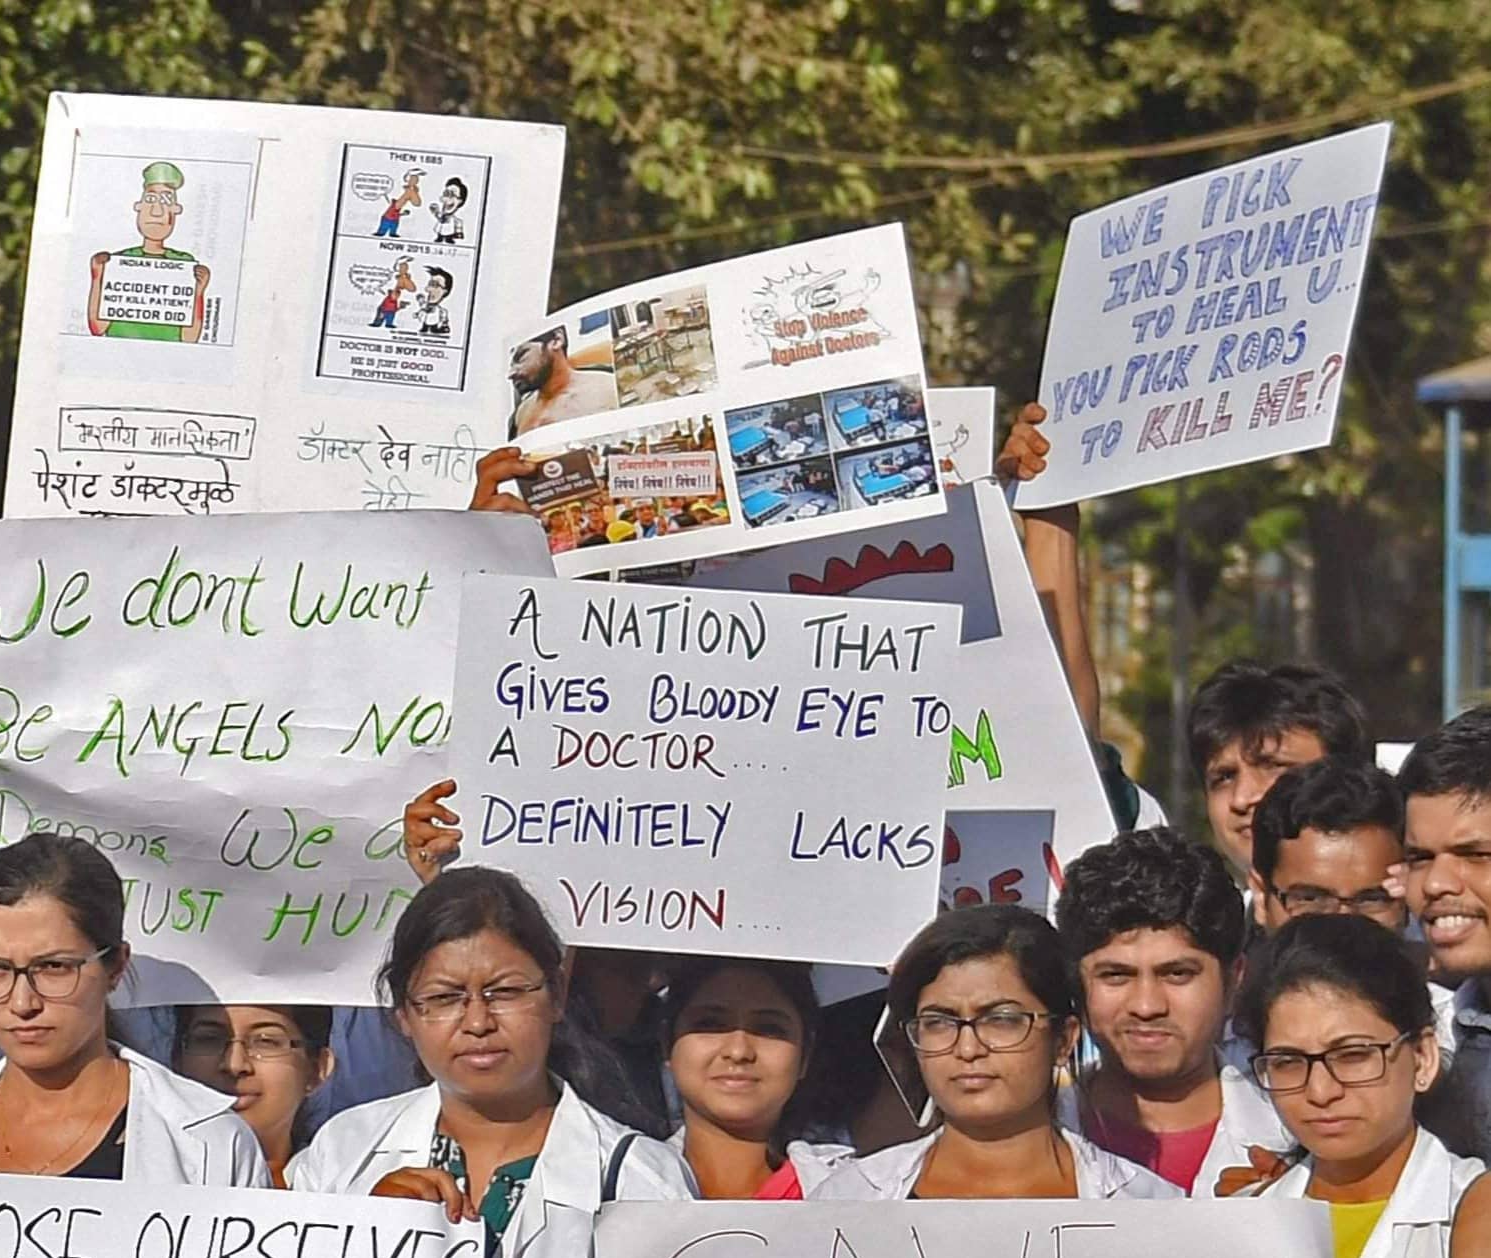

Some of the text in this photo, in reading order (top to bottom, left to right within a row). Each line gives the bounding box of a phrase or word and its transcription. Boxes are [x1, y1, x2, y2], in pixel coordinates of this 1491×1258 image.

[389, 152, 416, 163] THEN
[1099, 157, 1304, 260] WE PICK
[119, 259, 184, 270] INDIAN LOGIC
[379, 242, 404, 252] NOW
[1103, 193, 1378, 312] INSTRUMENT
[104, 281, 194, 297] ACCIDENT DID
[104, 295, 146, 305] NOT KILL
[1132, 304, 1175, 343] TO
[1185, 277, 1287, 336] HEAL
[107, 307, 186, 322] DOCTOR DID
[774, 308, 868, 338] Stop Violence
[340, 341, 382, 352] DOCTOR
[395, 346, 419, 356] NOT
[351, 356, 364, 365] HE
[400, 361, 433, 372] GOOD
[771, 331, 881, 366] Against Doctors
[1053, 320, 1307, 424] YOU PICK RODS
[377, 424, 417, 473] देव
[1082, 419, 1123, 465] TO
[1137, 391, 1232, 454] KILL
[531, 477, 565, 491] PROTECT
[123, 545, 266, 637] dont
[290, 560, 433, 630] Want
[510, 588, 558, 661] A
[803, 613, 935, 673] THAT
[648, 673, 779, 725] BLOODY
[795, 686, 884, 738] EYE
[911, 696, 951, 735] TO
[76, 693, 295, 778] ANGELS
[342, 694, 453, 756] NO
[488, 725, 520, 768] A
[222, 806, 336, 872] We
[791, 810, 935, 870] LACKS
